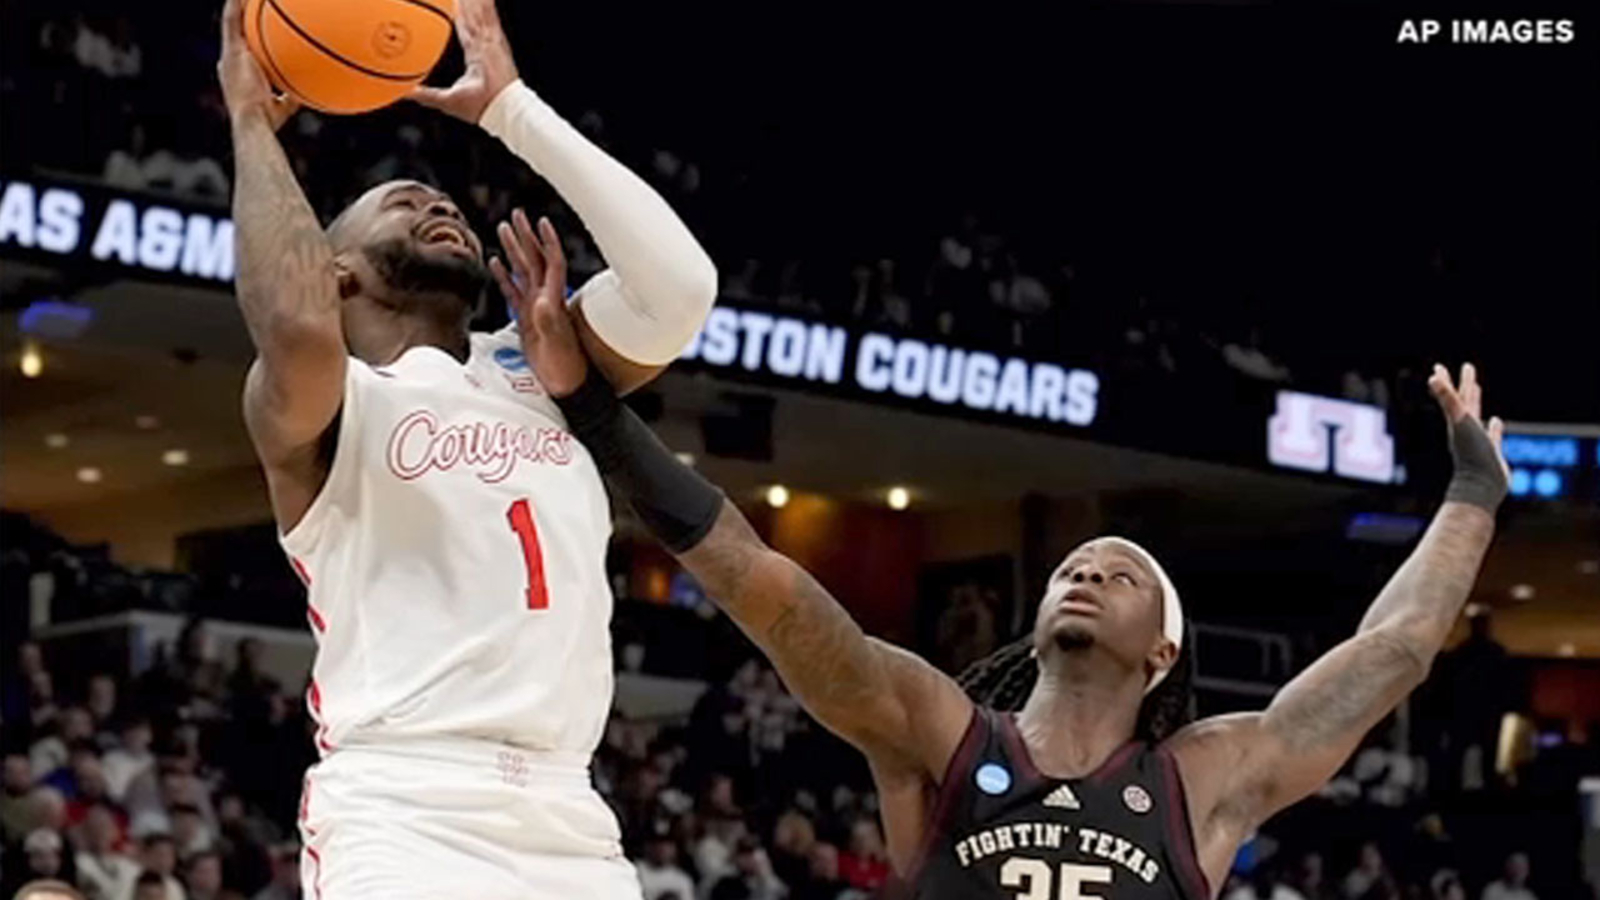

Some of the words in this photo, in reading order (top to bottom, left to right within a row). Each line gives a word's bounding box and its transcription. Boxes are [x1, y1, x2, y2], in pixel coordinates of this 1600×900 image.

[91, 200, 235, 281] A&M
[681, 306, 847, 384] STON
[854, 332, 1099, 426] COUGARS
[387, 410, 572, 483] Cougars
[507, 498, 549, 610] 1
[955, 822, 1070, 868] FIGHTIN'
[1078, 828, 1160, 884] TEXAS
